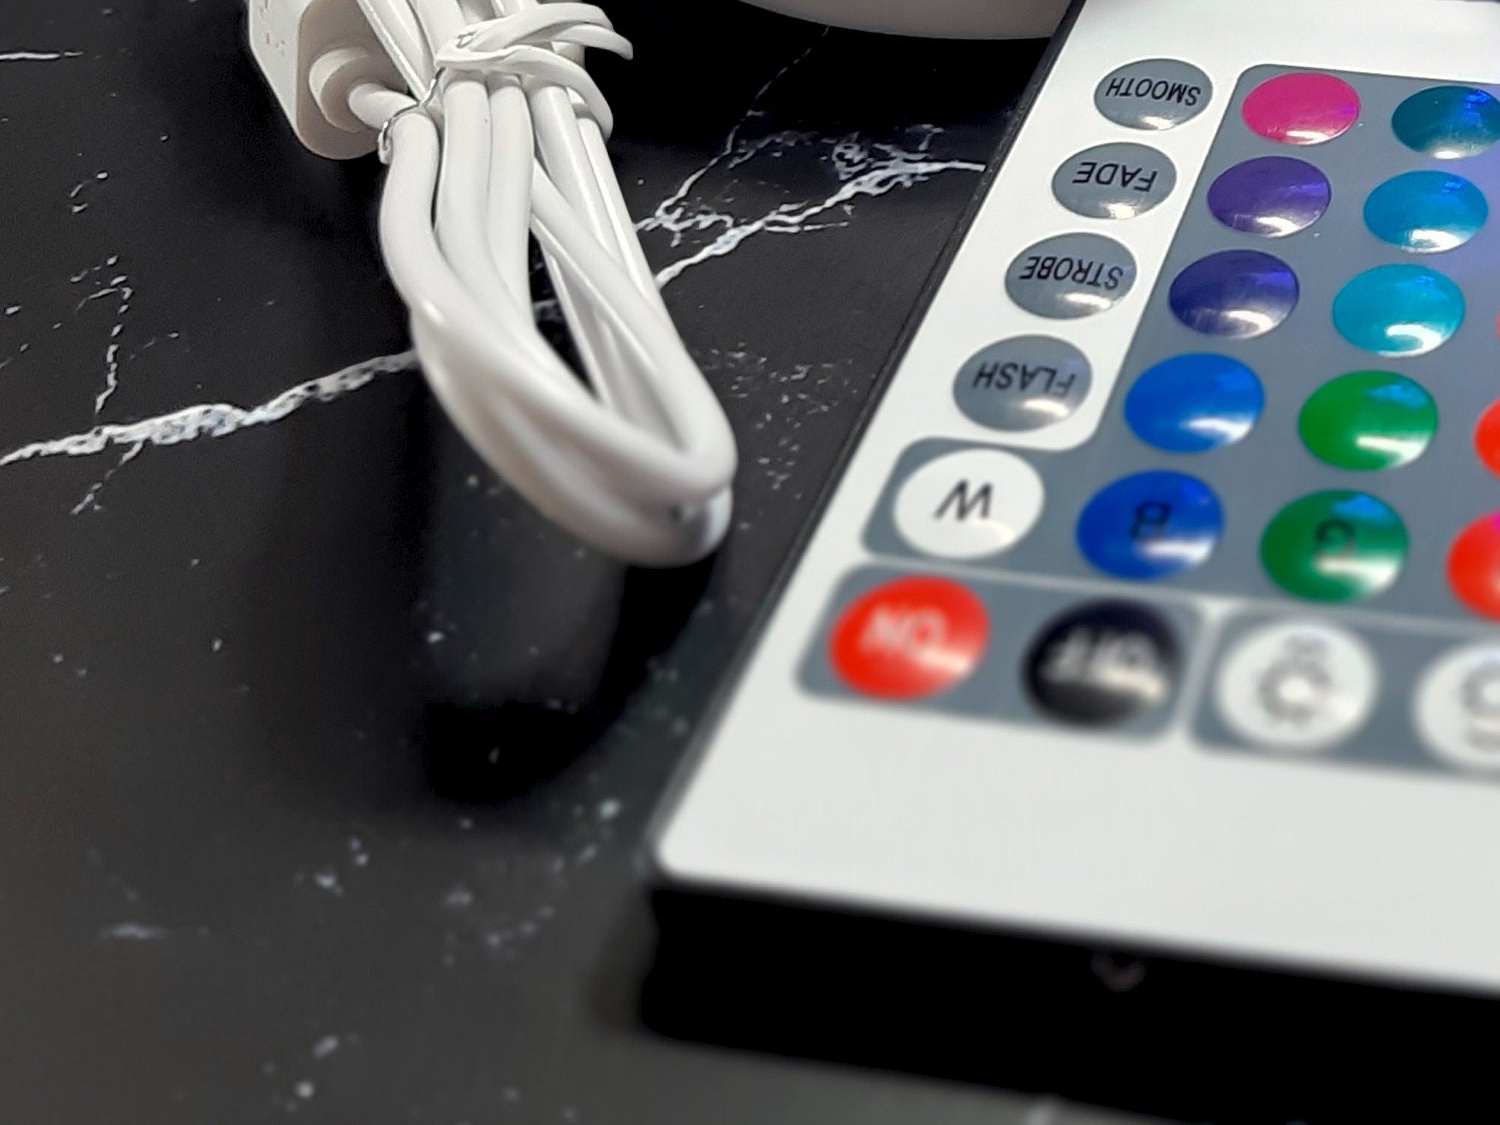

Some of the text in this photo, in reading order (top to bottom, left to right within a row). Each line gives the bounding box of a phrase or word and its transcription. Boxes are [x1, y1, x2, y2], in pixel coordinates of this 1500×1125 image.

[1105, 77, 1202, 107] SMOOTH
[1072, 161, 1158, 193] FADE
[1019, 256, 1125, 290] STROBE
[972, 362, 1077, 396] FLASH
[934, 479, 992, 521] W
[1131, 502, 1170, 543] B
[1314, 518, 1356, 561] G
[860, 606, 945, 655] ON
